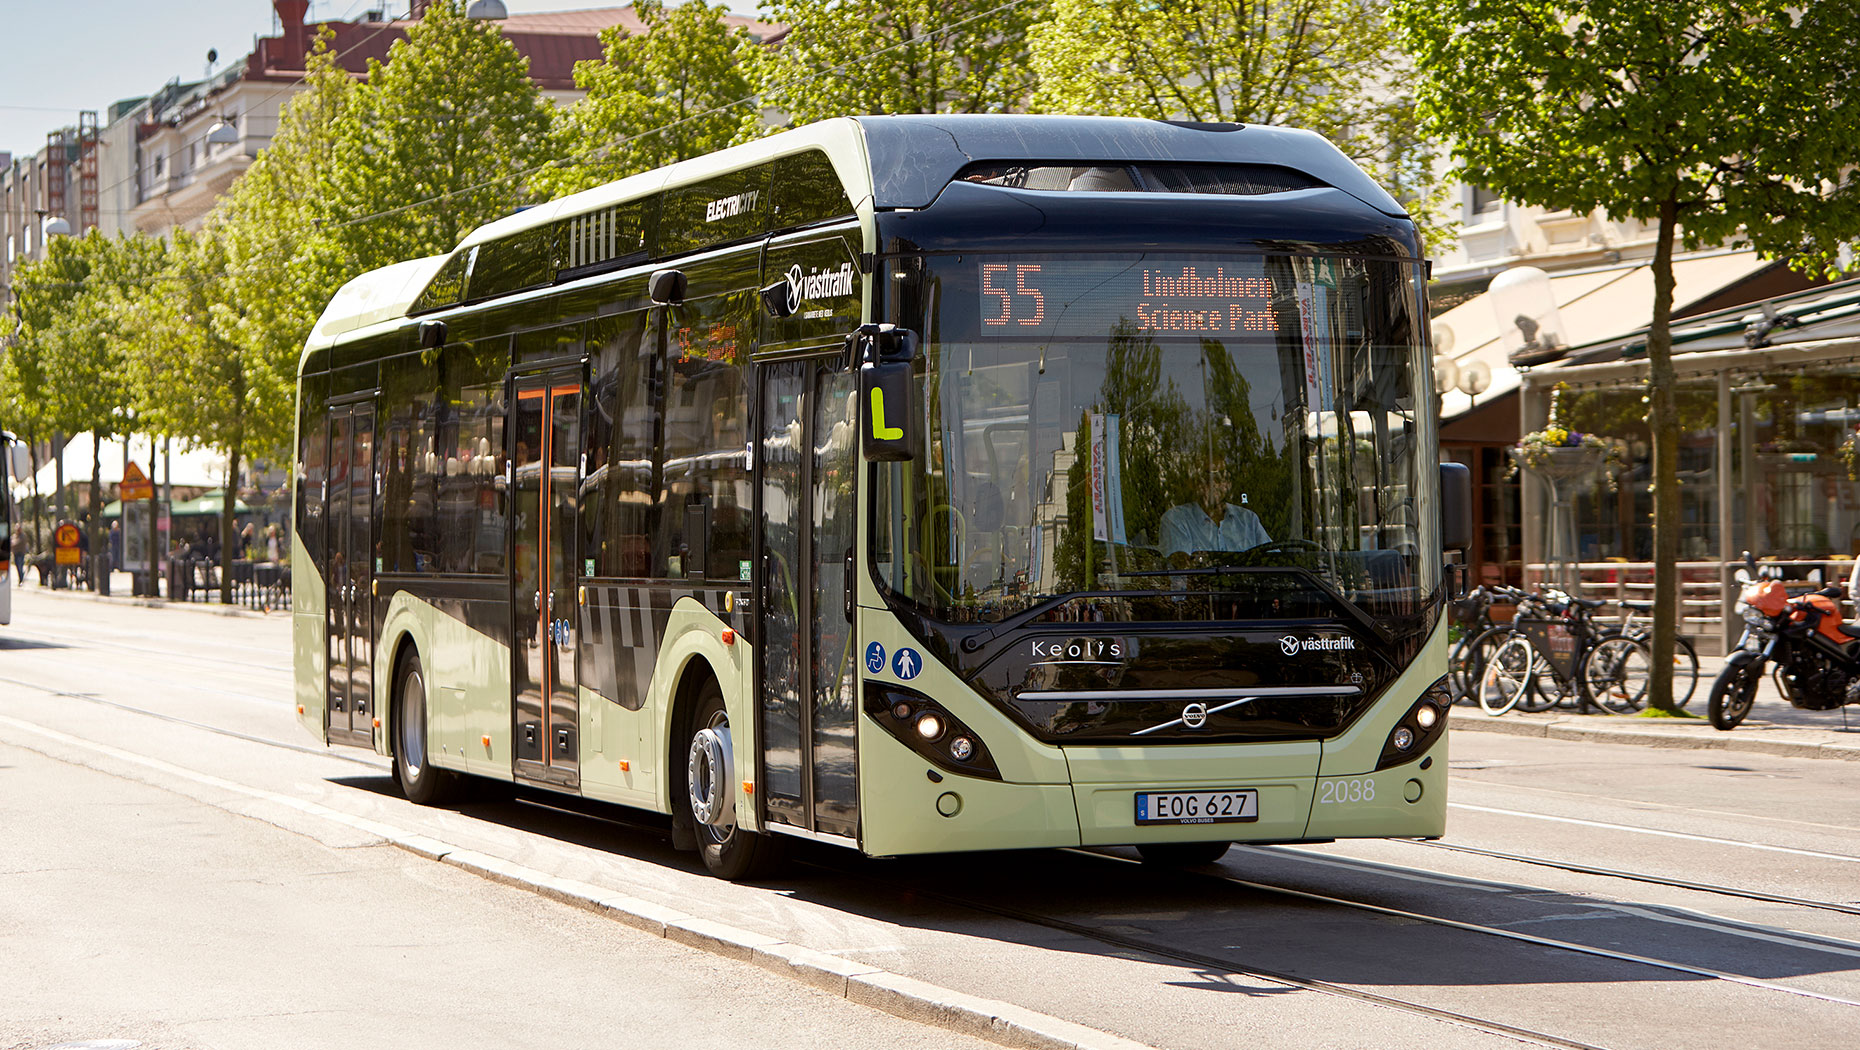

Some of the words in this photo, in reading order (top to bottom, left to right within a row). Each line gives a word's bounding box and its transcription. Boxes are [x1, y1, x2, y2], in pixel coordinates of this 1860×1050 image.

[705, 190, 760, 223] ELECTRICITY
[804, 262, 854, 300] västtrafik
[983, 264, 1044, 326] 55
[1143, 266, 1272, 298] Lindholmen
[1137, 302, 1223, 331] Science
[1229, 300, 1279, 331] Park
[1032, 640, 1121, 657] Keolis
[1301, 635, 1355, 651] västtrafik
[1157, 796, 1198, 817] EOG
[1205, 794, 1247, 816] 627
[1321, 779, 1375, 804] 2038
